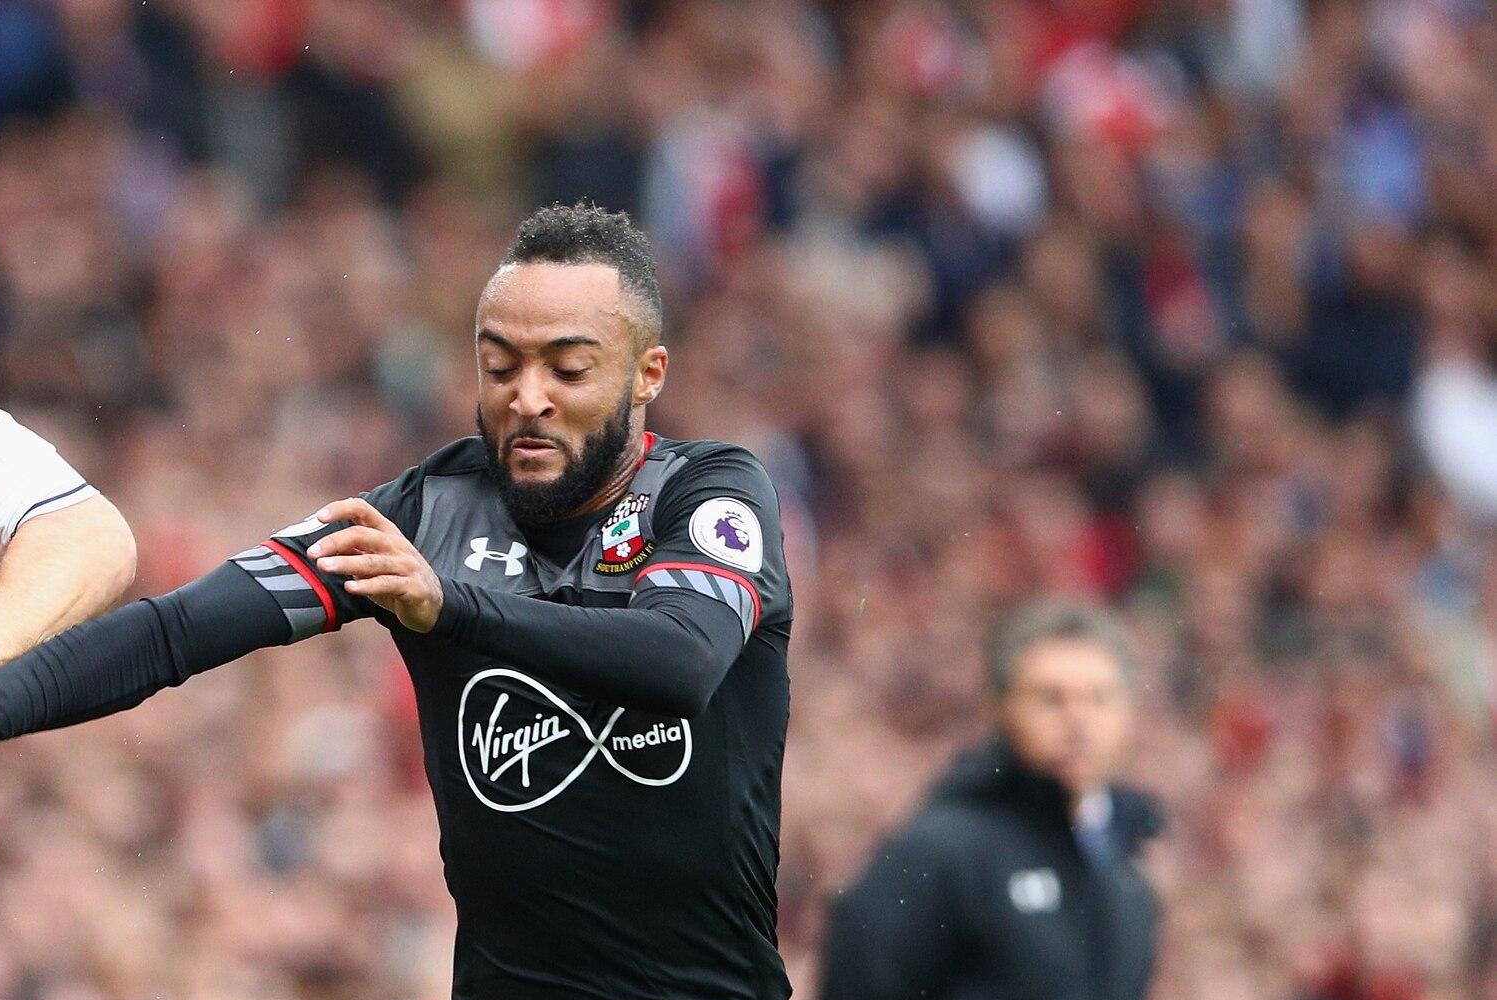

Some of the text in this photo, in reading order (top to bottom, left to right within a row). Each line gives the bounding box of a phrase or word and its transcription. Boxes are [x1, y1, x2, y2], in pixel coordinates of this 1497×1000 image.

[595, 550, 648, 573] SOUTHAMPTON
[471, 692, 682, 788] Virgin media
